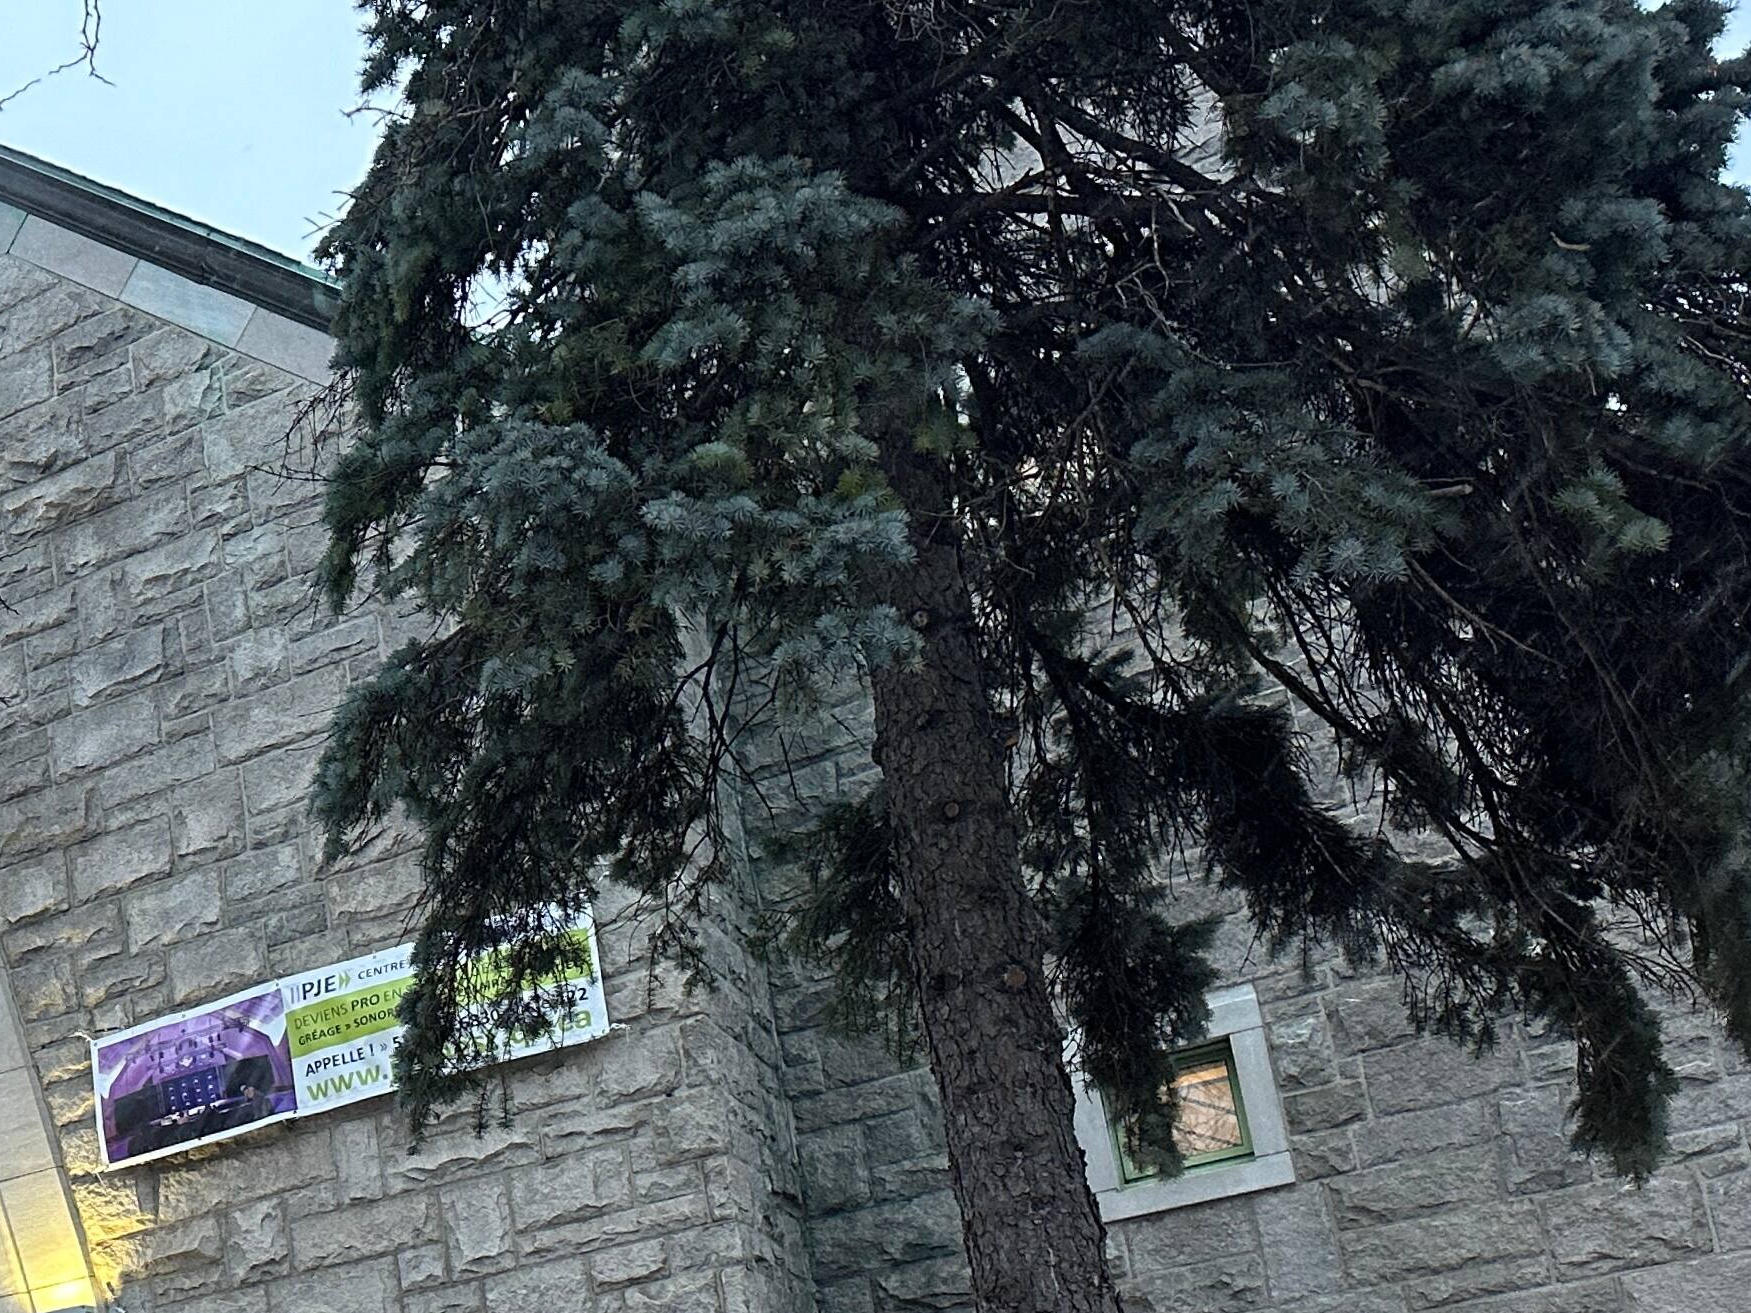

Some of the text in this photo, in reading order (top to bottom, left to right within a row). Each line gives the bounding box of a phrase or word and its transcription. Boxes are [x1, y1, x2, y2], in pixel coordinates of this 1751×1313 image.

[302, 959, 406, 1001] PJE CENTRE
[294, 986, 402, 1031] DEVIENS PRO EN
[298, 1007, 398, 1046] GRÉAGE SONOR
[305, 1047, 366, 1078] APPELLE
